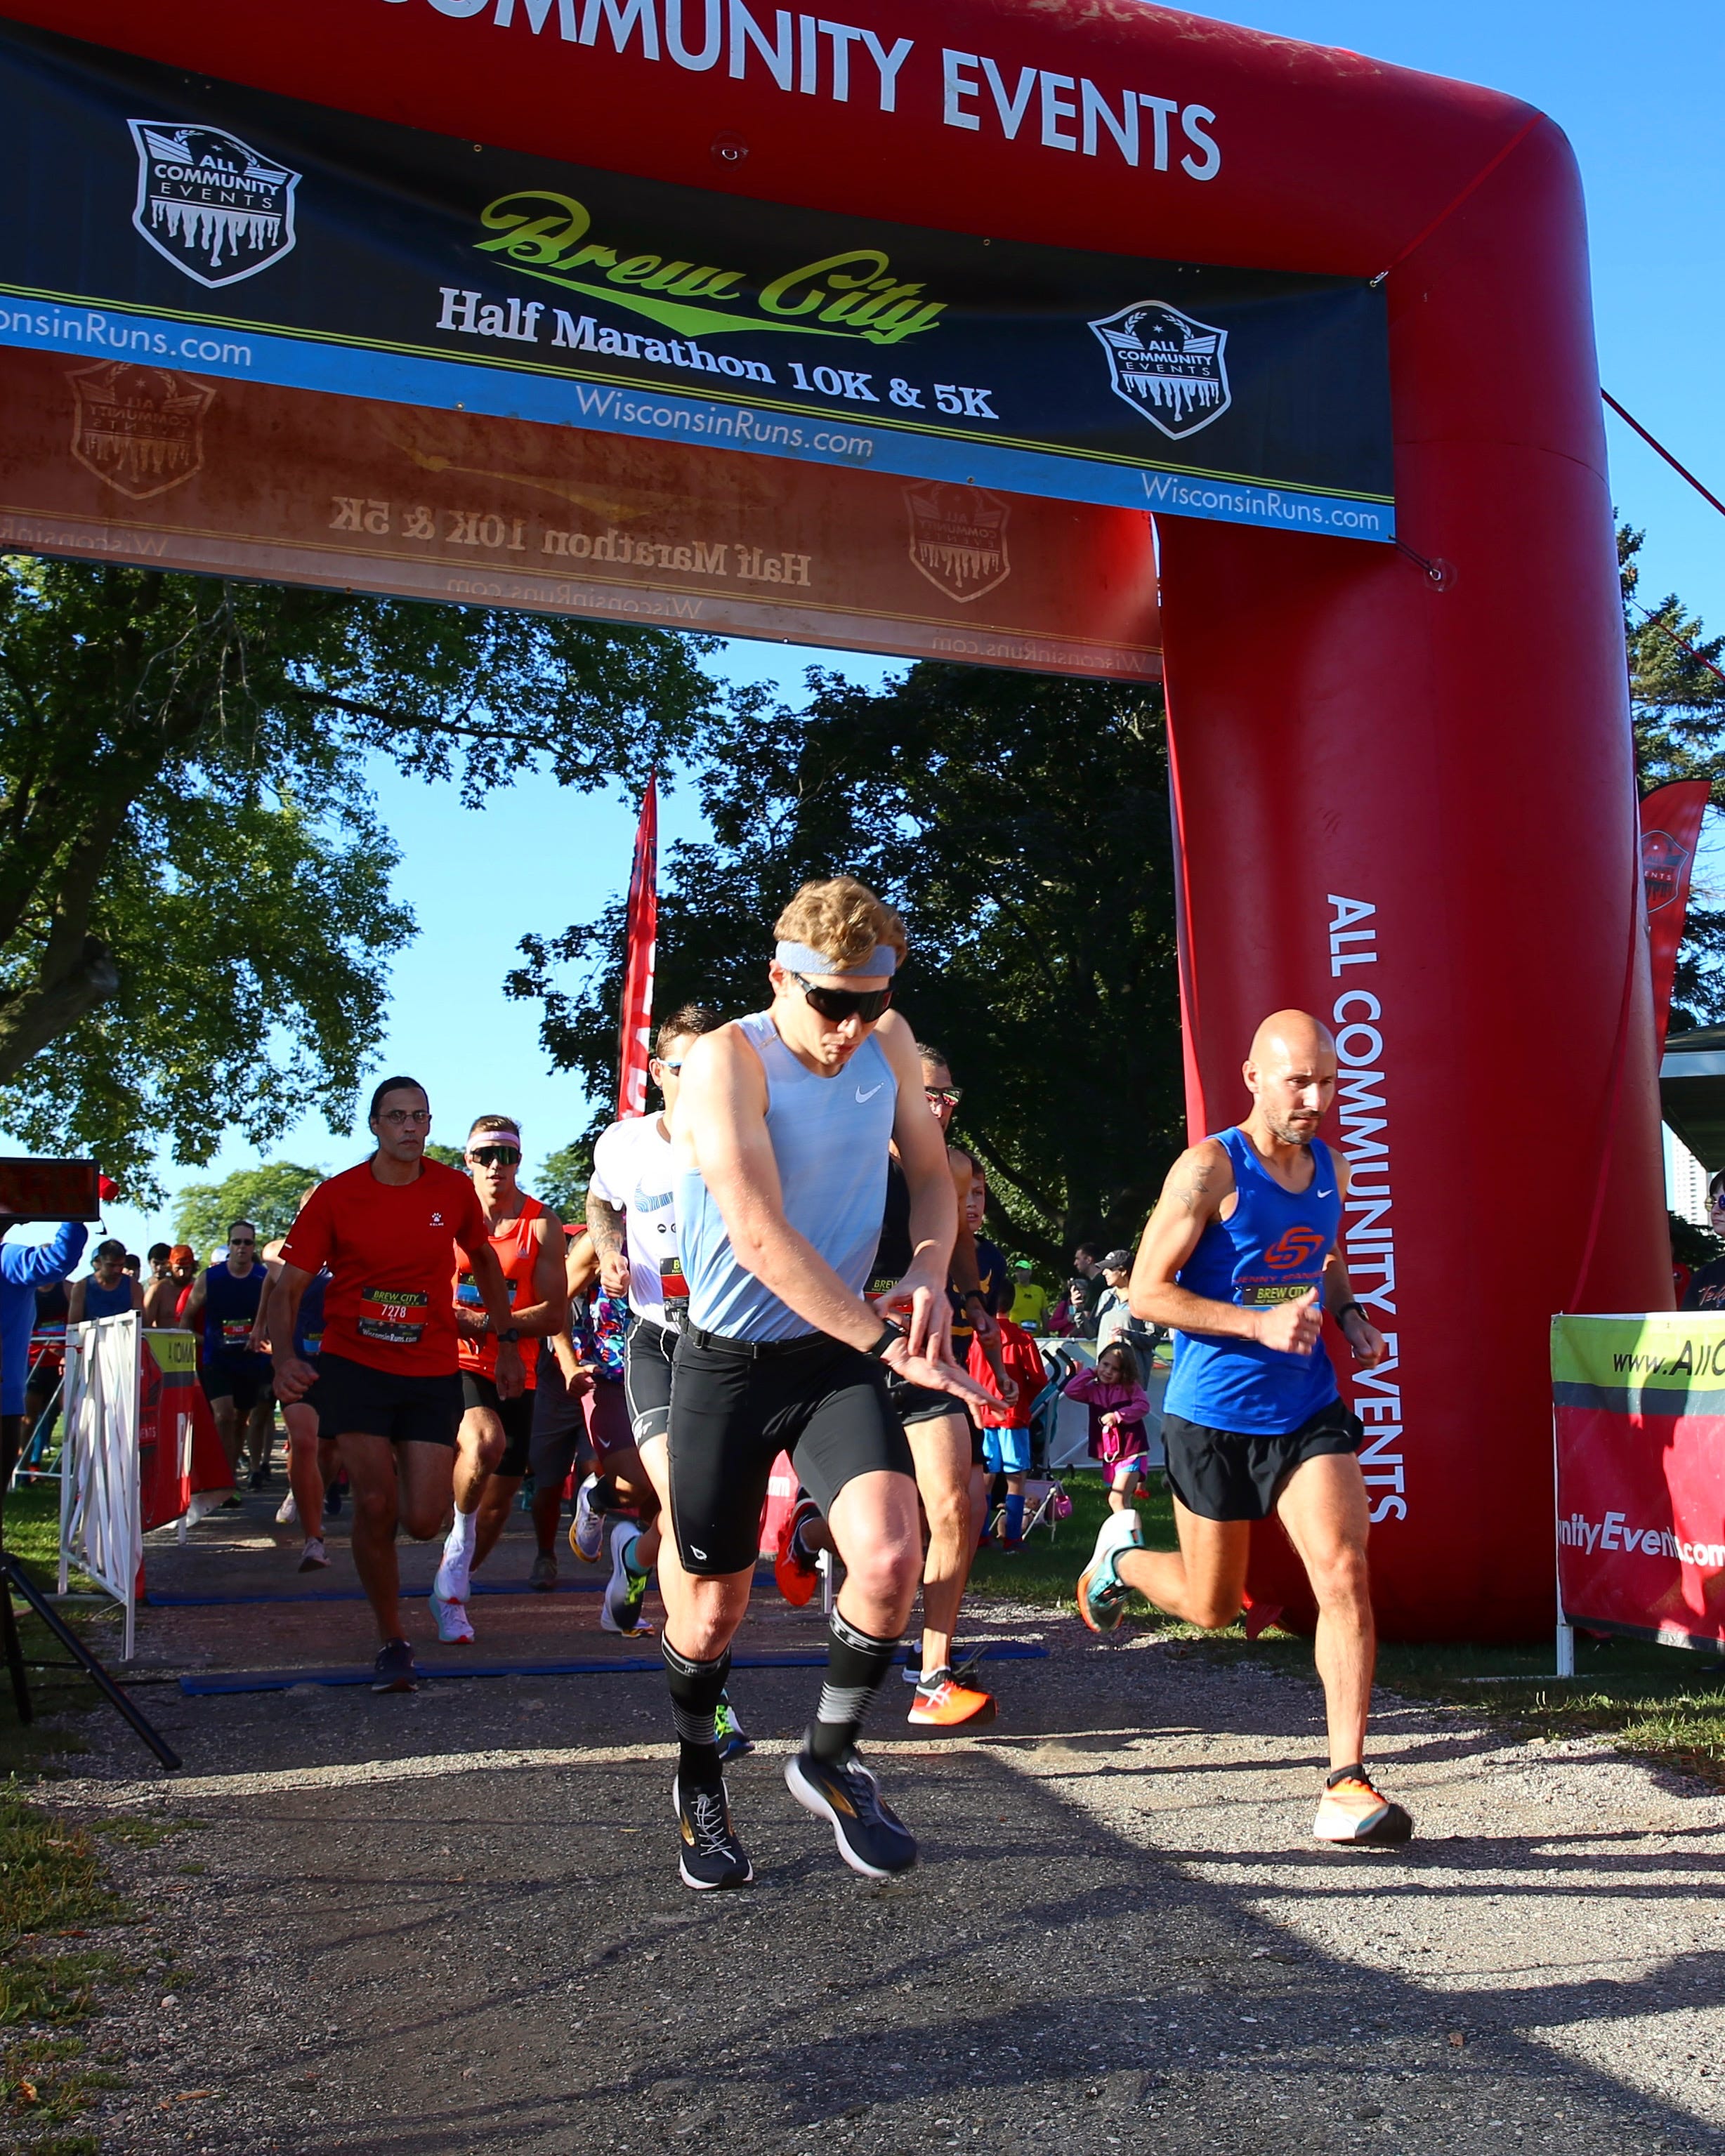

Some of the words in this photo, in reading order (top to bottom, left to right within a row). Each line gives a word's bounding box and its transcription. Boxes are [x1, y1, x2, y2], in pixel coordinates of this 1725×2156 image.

[383, 0, 914, 112] MUNITY
[942, 48, 1221, 181] EVENTS
[199, 154, 239, 174] ALL
[154, 164, 280, 197] COMMUNITY
[161, 181, 273, 210] EVENTS
[472, 190, 747, 300] Brew
[758, 249, 949, 346] City
[435, 287, 545, 343] Half
[551, 308, 777, 385] Marathon
[787, 362, 881, 403] 10K
[888, 377, 926, 409] &
[933, 383, 1000, 420] 5K
[1117, 350, 1213, 366] COMMUNITY
[1148, 340, 1179, 353] ALL
[1125, 362, 1211, 376] EVENTS
[575, 385, 874, 458] WisconsinRuns.com
[1141, 473, 1379, 531] WisconsinRuns.com
[1327, 893, 1378, 978] ALL
[1332, 990, 1396, 1315] COMMUNITY
[374, 1290, 400, 1301] BREW
[400, 1294, 420, 1303] CITY
[1257, 1287, 1287, 1299] BREW
[1288, 1285, 1308, 1299] CITY
[381, 1303, 407, 1319] 7278
[362, 1328, 418, 1343] WisconsinRuns.com
[1559, 1511, 1725, 1567] nityEvent.com
